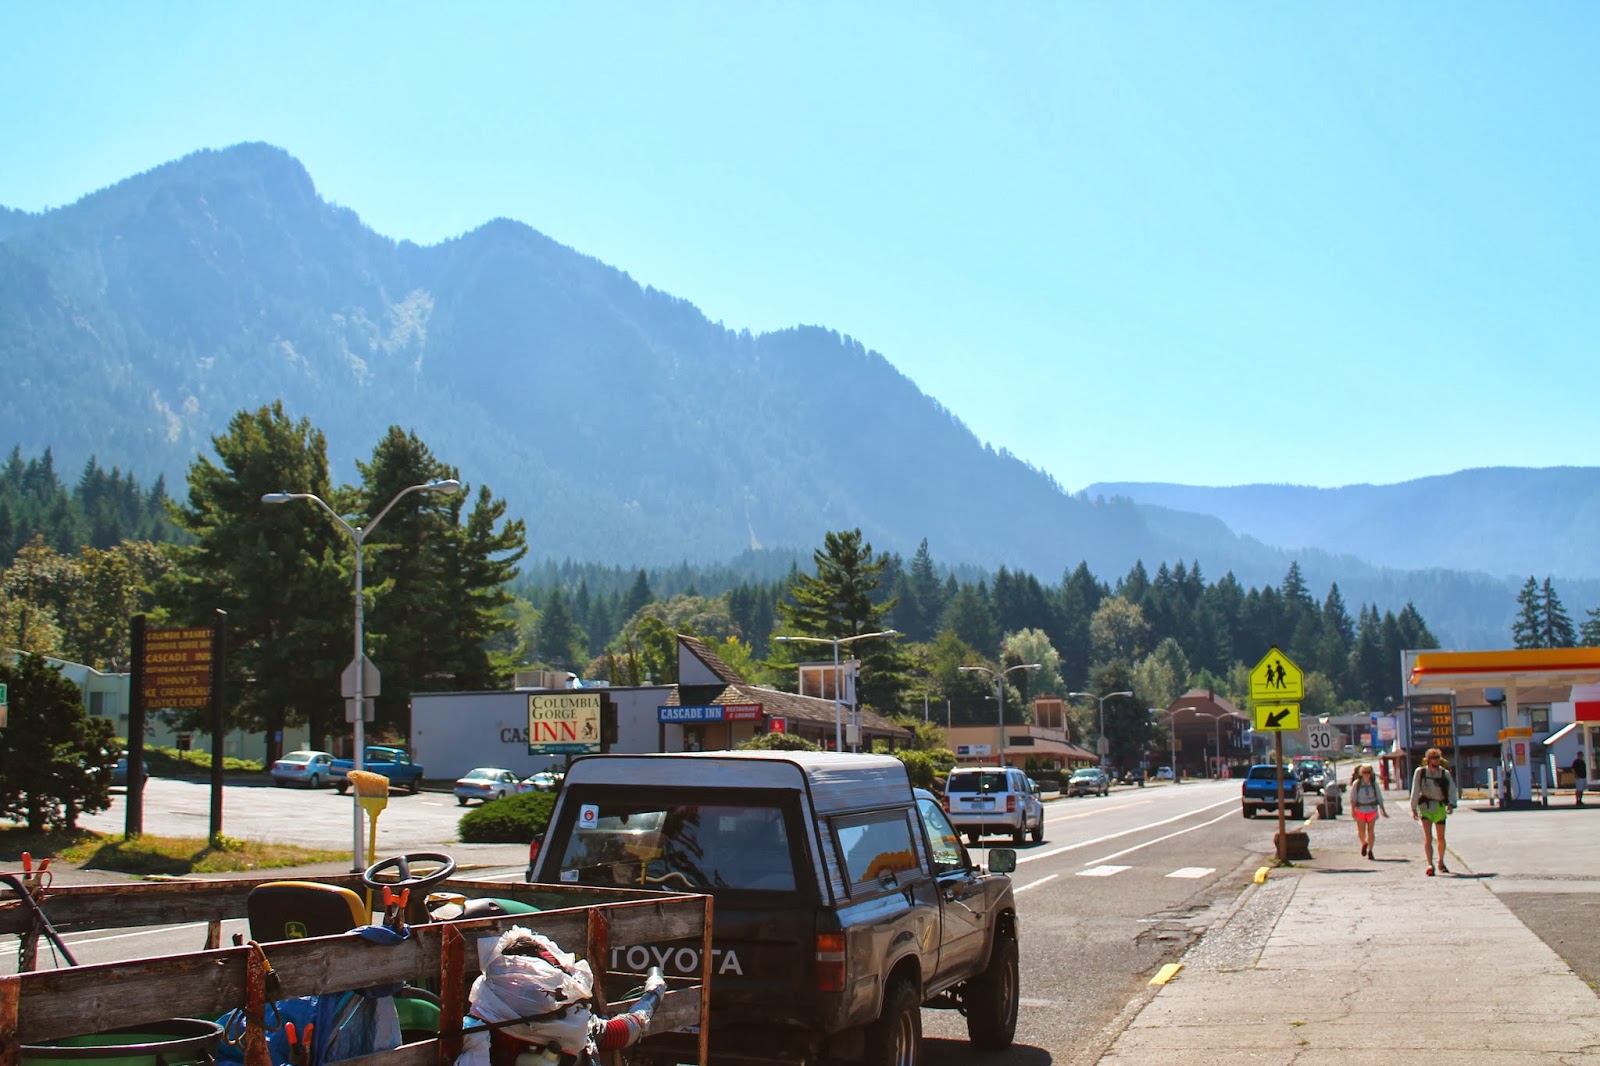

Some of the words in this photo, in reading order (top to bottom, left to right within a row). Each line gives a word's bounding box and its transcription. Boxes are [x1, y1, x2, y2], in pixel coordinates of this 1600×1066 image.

[145, 653, 187, 663] CASCADE
[157, 676, 198, 685] JOHNNY'S
[179, 697, 207, 707] COURT
[532, 696, 600, 709] COLUMBIA
[532, 707, 578, 719] GORGE
[660, 707, 703, 720] CASCADE
[705, 707, 722, 719] INN
[533, 721, 578, 742] INN
[1310, 732, 1330, 748] 30
